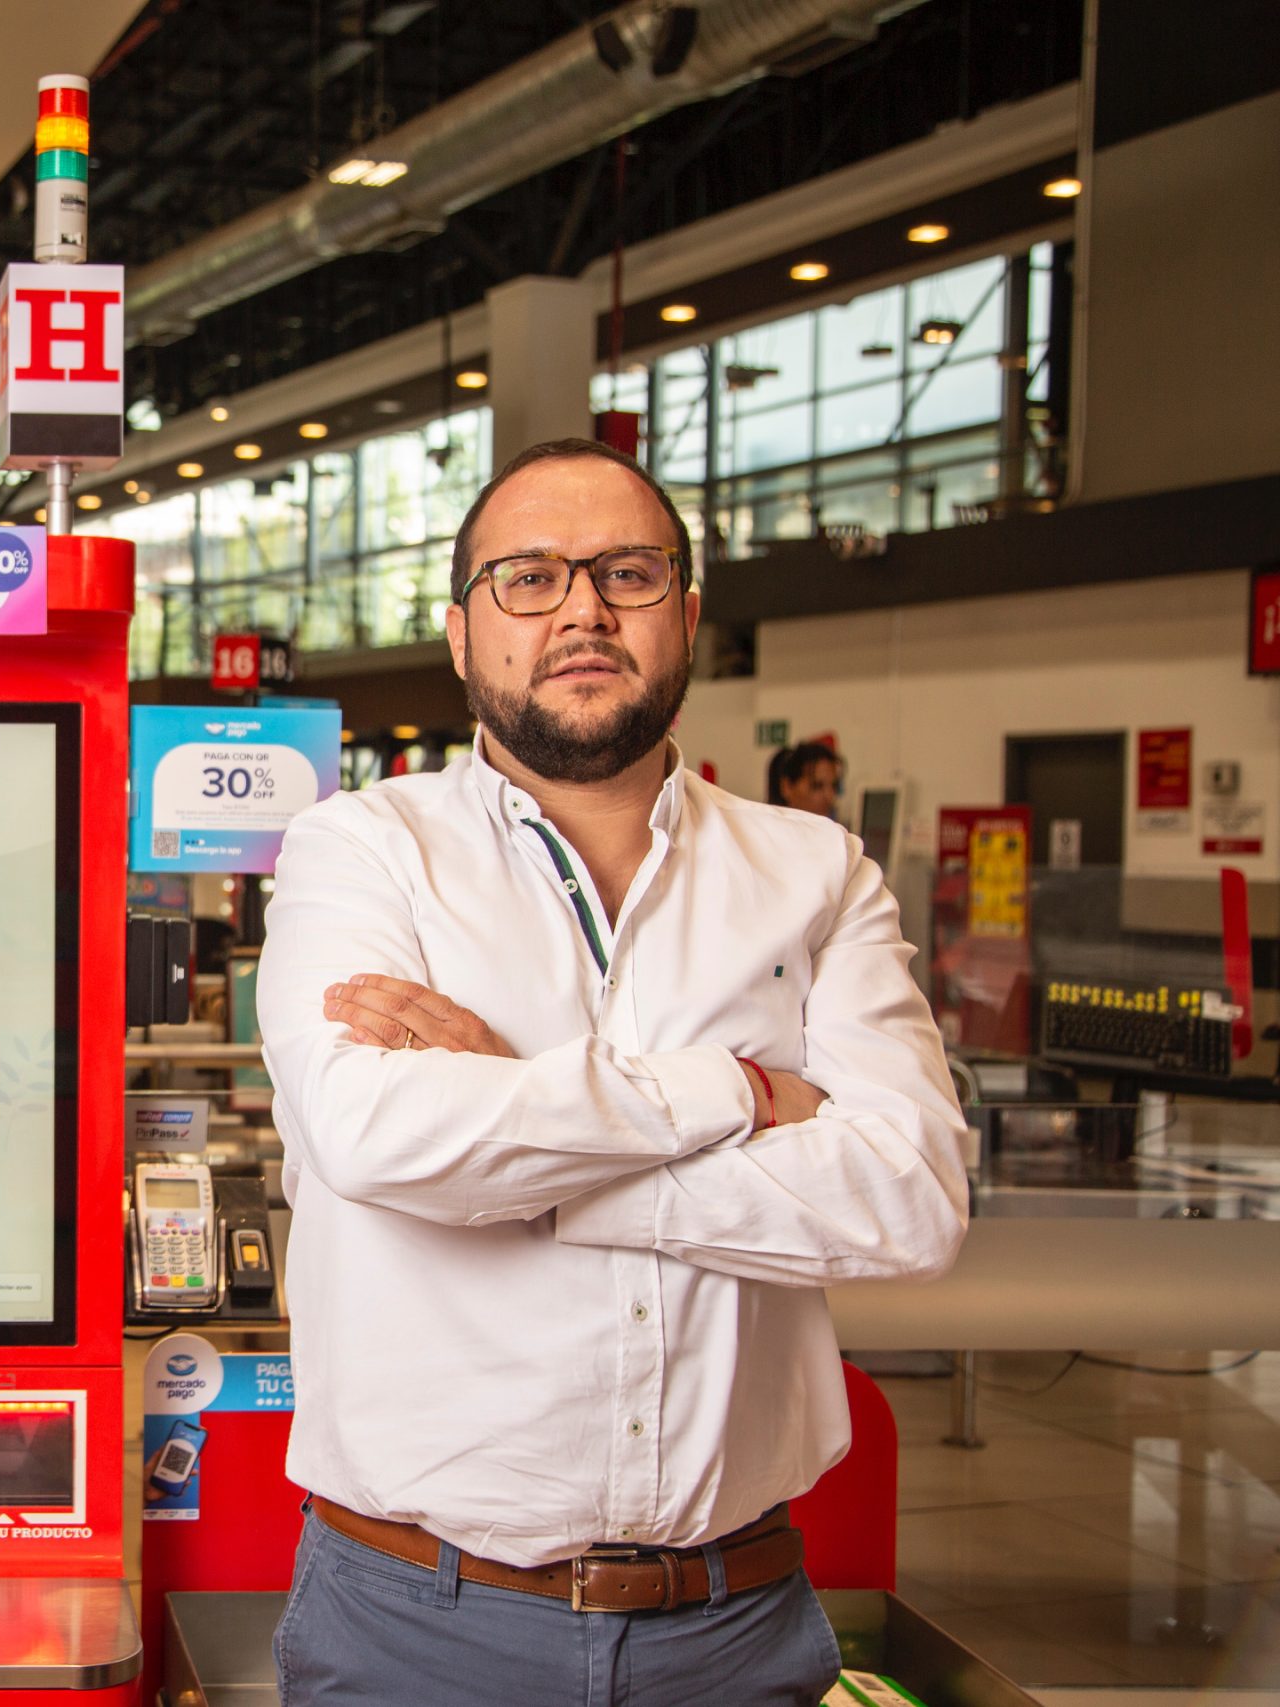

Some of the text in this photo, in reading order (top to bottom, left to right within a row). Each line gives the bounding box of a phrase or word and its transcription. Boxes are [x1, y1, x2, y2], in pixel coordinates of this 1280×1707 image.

[15, 289, 120, 382] H
[216, 646, 255, 679] 16
[204, 753, 270, 761] PAGA CON QR
[253, 791, 275, 799] OFF
[157, 1379, 206, 1389] mercado
[256, 1379, 279, 1392] TU
[168, 1389, 196, 1400] pago
[12, 1527, 93, 1538] PRODUCTO
